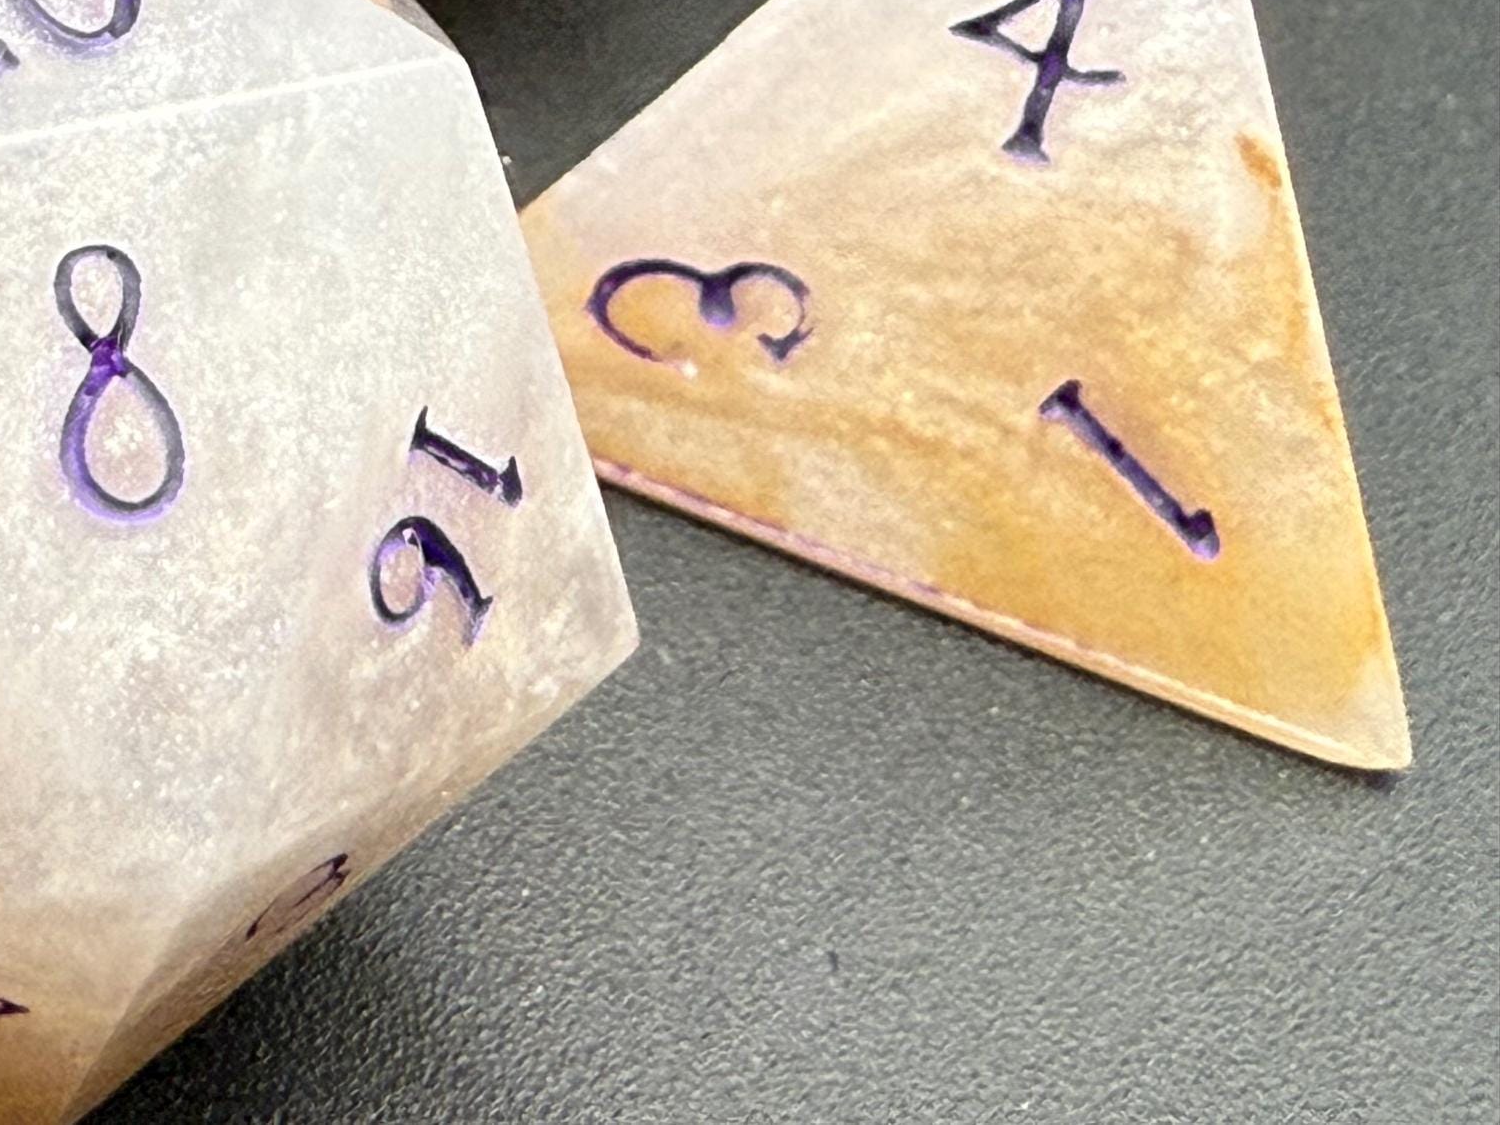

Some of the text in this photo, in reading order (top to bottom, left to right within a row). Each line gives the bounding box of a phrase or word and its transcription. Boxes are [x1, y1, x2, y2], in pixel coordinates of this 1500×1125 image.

[54, 236, 185, 523] 8
[585, 258, 812, 372] 3
[368, 405, 522, 647] 16
[1038, 380, 1220, 561] 1
